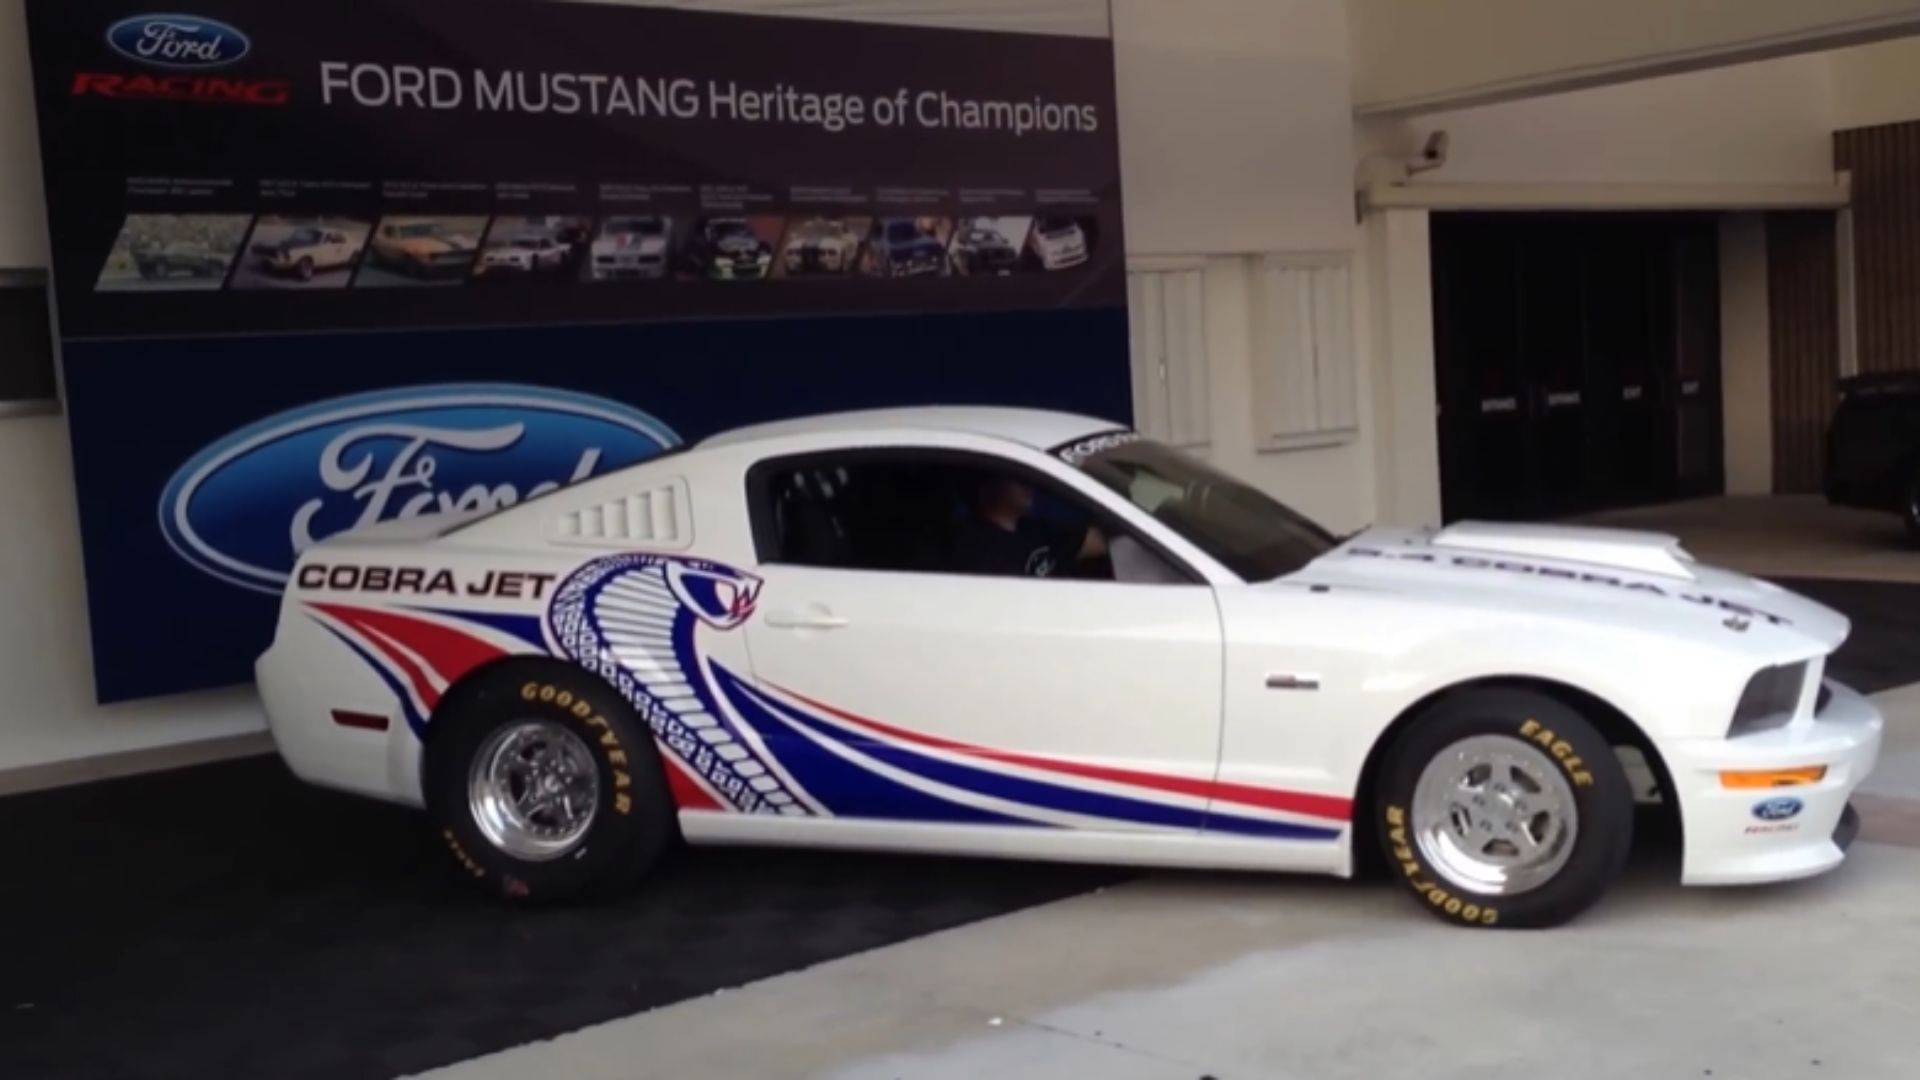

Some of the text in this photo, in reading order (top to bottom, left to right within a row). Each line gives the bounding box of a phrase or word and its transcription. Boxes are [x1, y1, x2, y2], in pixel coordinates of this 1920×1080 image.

[135, 21, 222, 60] Ford
[71, 71, 290, 105] RACING
[320, 61, 1098, 136] FORD MUSTANG Heritage of Champions
[297, 563, 557, 600] COBRA JET
[520, 681, 632, 814] GOODYEAR
[1519, 718, 1594, 786] EAGLE
[1386, 805, 1499, 925] GOODYEAR
